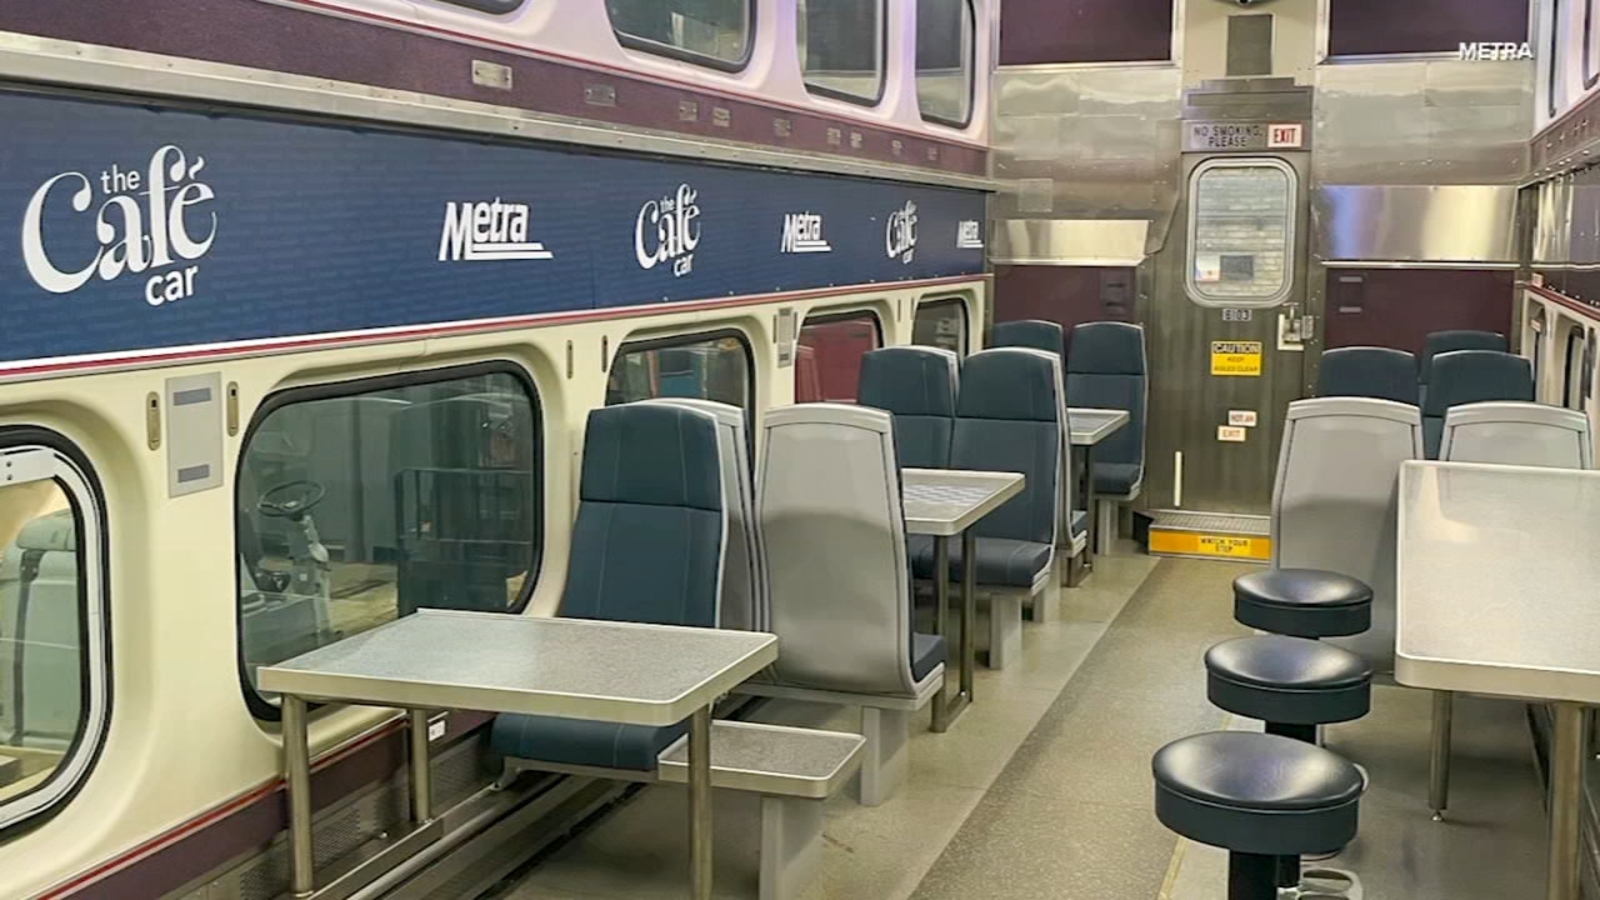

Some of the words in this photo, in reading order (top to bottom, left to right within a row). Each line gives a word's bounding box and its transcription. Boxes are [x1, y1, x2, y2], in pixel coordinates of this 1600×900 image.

[1194, 125, 1210, 137] NO
[1208, 136, 1247, 147] PLEASE
[1273, 128, 1297, 144] EXIT
[101, 164, 141, 193] the
[22, 145, 217, 293] Café
[438, 197, 532, 261] Metra
[635, 183, 701, 270] Café
[781, 210, 823, 253] Metra
[674, 254, 694, 277] car
[146, 265, 198, 306] car
[1213, 342, 1259, 354] CAUTION
